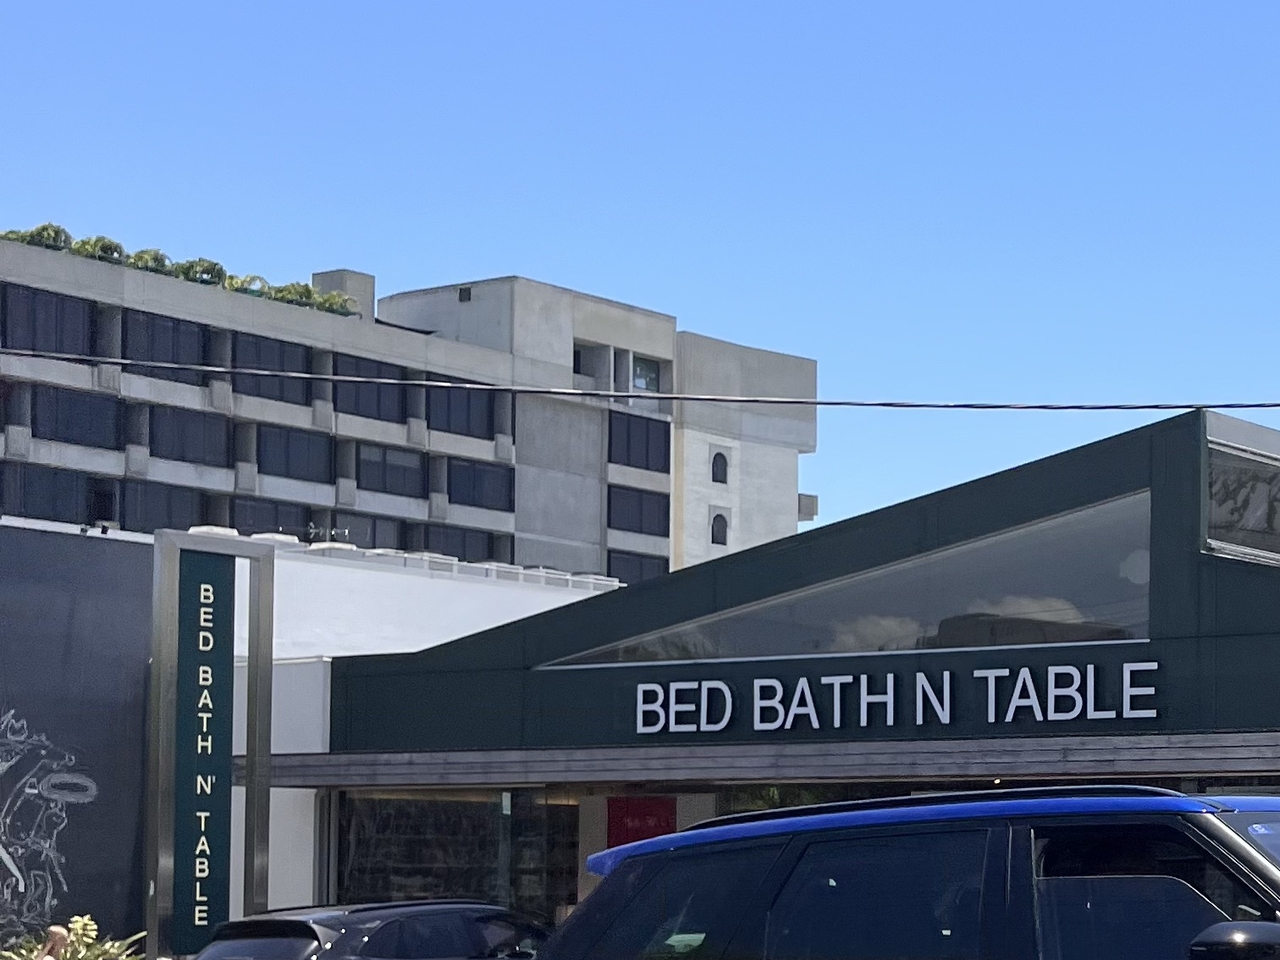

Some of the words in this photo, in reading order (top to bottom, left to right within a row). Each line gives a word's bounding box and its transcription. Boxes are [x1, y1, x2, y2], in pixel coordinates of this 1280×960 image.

[198, 583, 215, 652] BED
[197, 665, 213, 755] BATH
[636, 681, 733, 734] BED
[753, 673, 894, 731] BATH
[915, 670, 950, 726] N
[973, 661, 1159, 723] TABLE
[194, 811, 211, 926] TABLE
